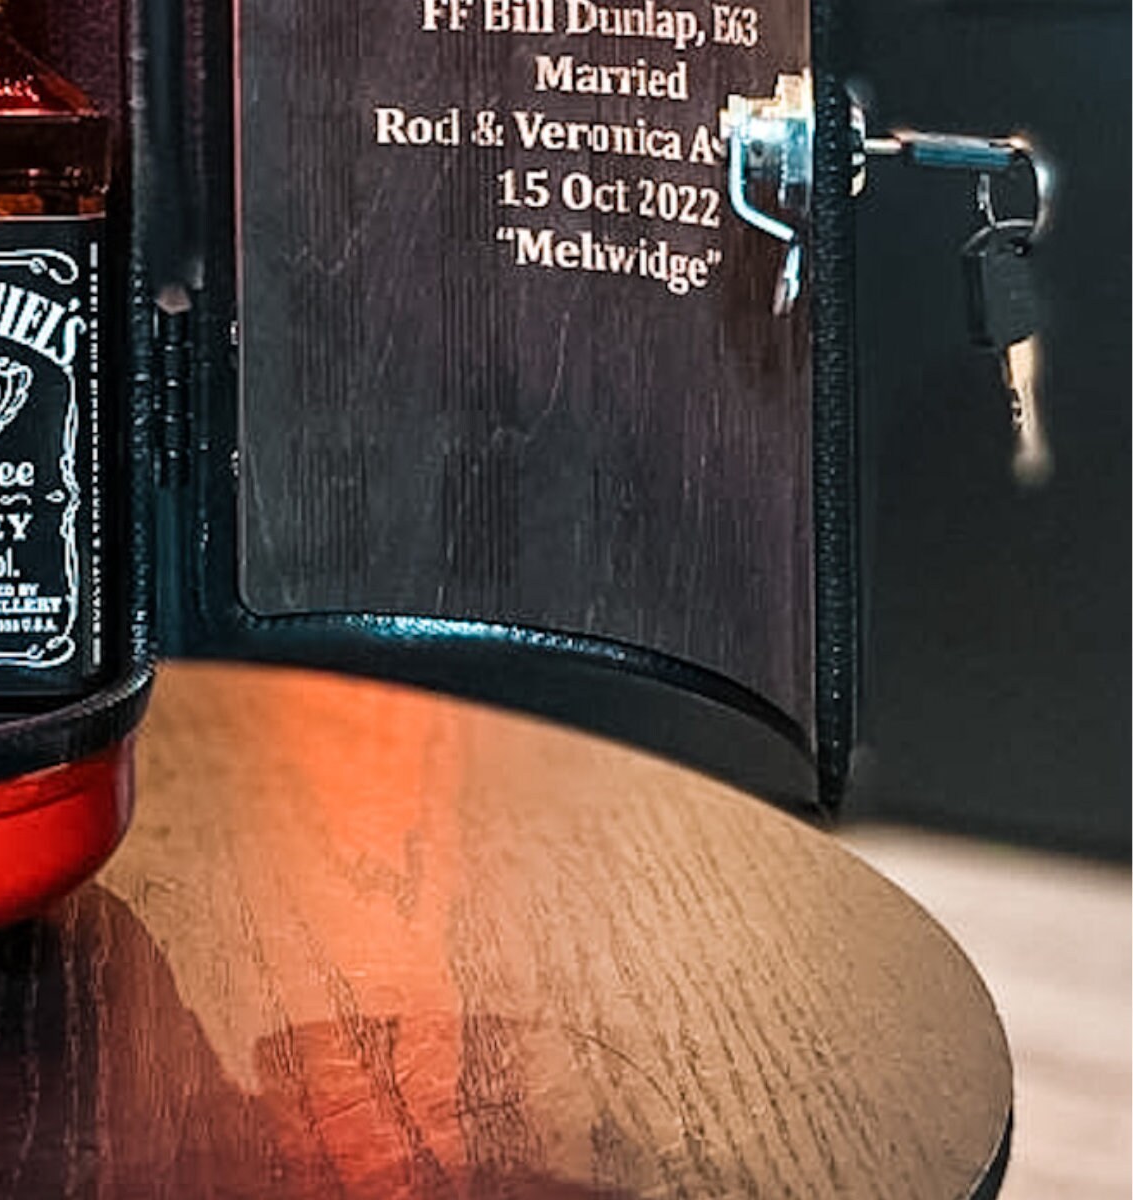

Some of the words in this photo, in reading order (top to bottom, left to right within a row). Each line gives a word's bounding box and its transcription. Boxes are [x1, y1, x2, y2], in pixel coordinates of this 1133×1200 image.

[711, 4, 758, 48] E63
[534, 55, 689, 100] Married
[374, 107, 460, 146] Rod
[471, 110, 504, 148] &
[514, 111, 683, 161] Veronica
[496, 168, 551, 209] 15
[561, 172, 630, 214] Oct
[638, 179, 722, 229] 2022
